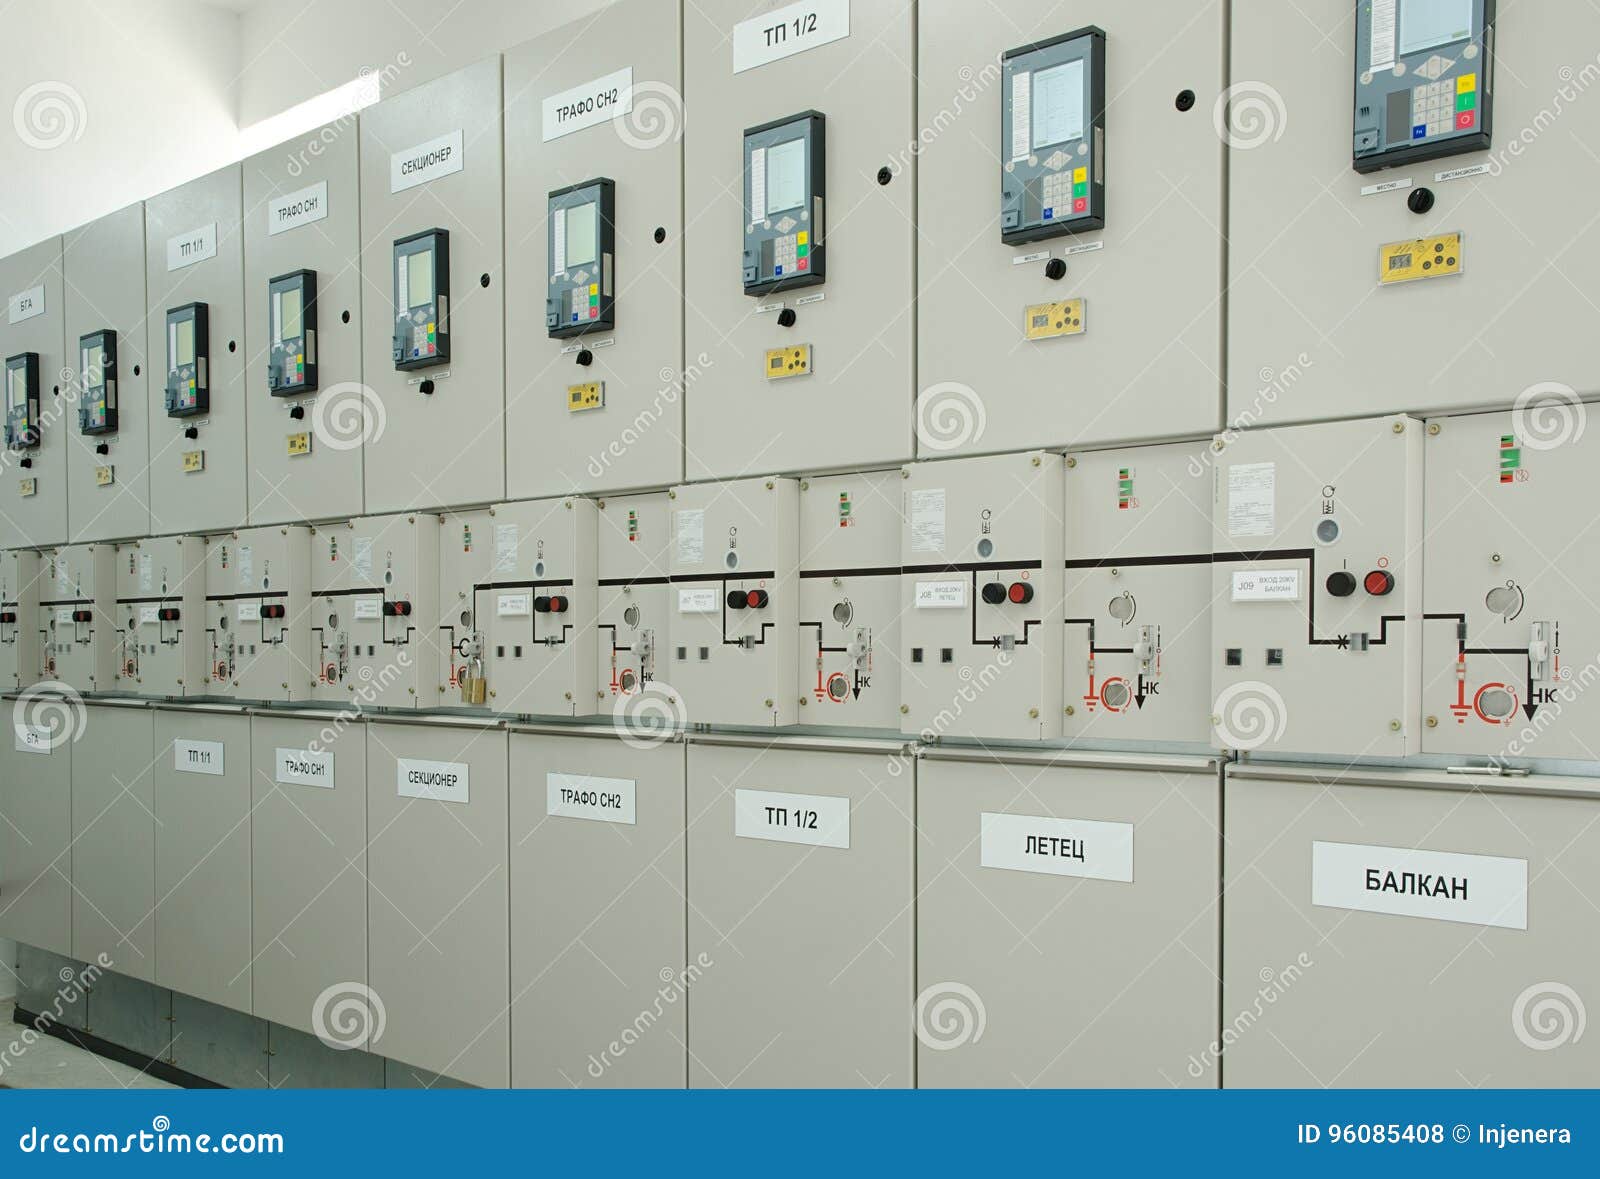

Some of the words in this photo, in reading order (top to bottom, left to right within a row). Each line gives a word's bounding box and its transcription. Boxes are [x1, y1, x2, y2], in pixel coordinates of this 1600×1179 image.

[762, 23, 787, 47] ТП
[792, 12, 818, 37] 1/2
[556, 97, 594, 123] ТРАФО
[596, 88, 618, 109] СН2
[401, 146, 452, 175] СЕКЦИОНЕР
[277, 202, 303, 221] ТРАФО
[304, 197, 318, 212] СН1
[180, 242, 191, 257] ТП
[187, 749, 199, 762] ТП
[285, 760, 310, 775] ТРАФО
[311, 762, 325, 776] СН1
[408, 770, 458, 788] СЕКЦИОНЕР
[560, 788, 597, 806] ТРАФО
[600, 791, 622, 809] СН2
[764, 806, 788, 826] ТП
[793, 809, 818, 830] 1/2
[1024, 834, 1085, 863] ЛЕТЕЦ
[1365, 868, 1468, 900] БАЛКАН
